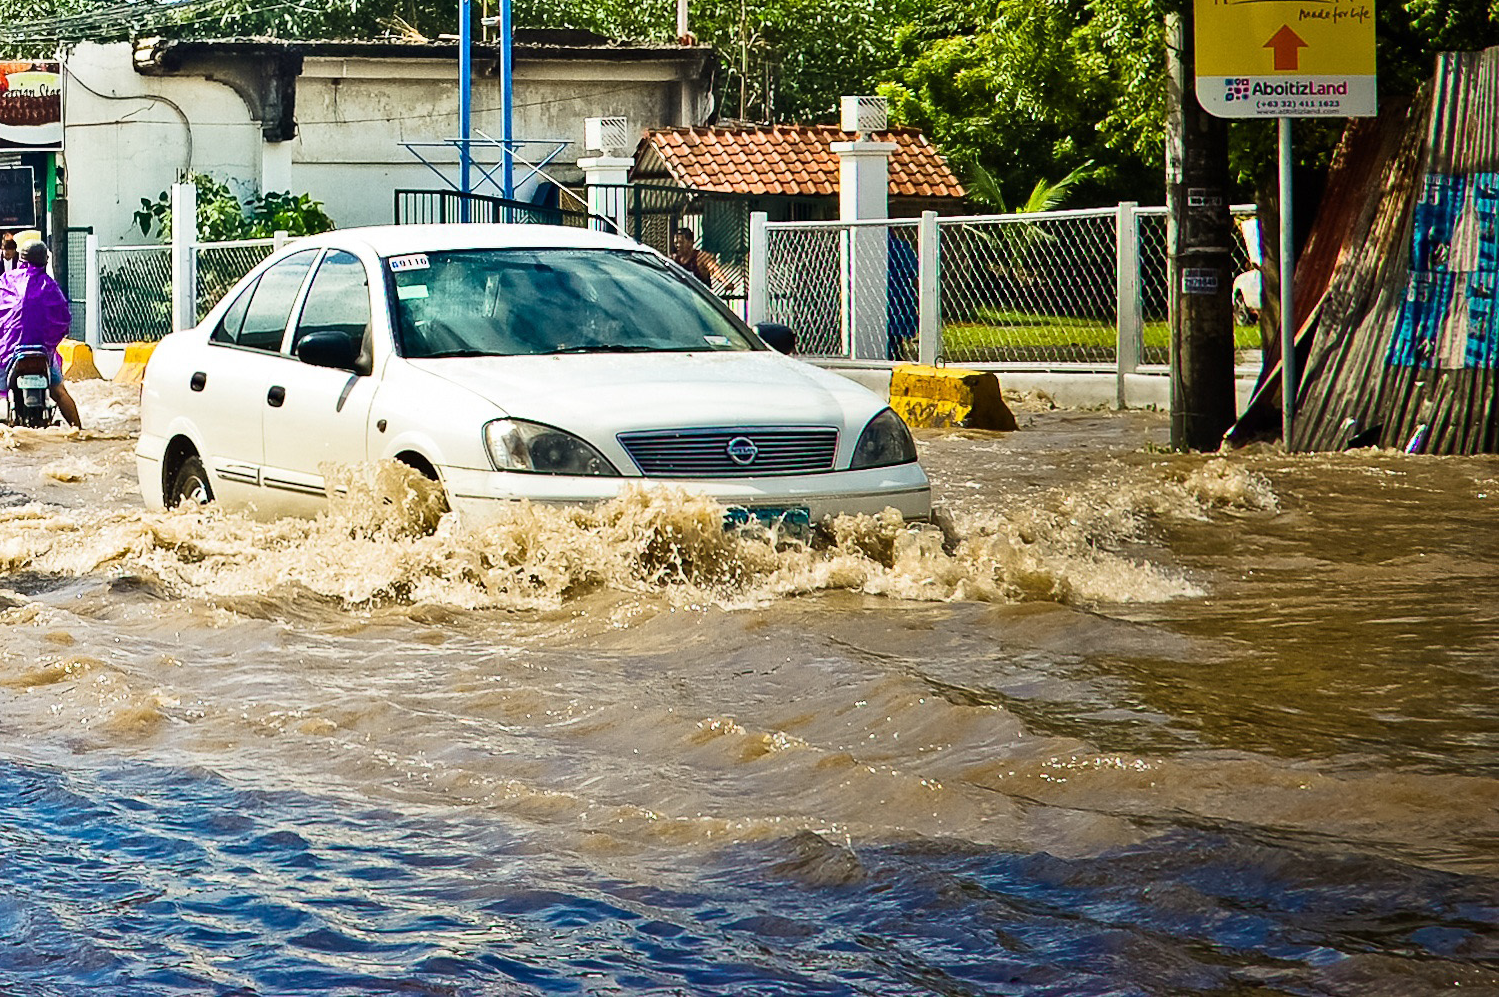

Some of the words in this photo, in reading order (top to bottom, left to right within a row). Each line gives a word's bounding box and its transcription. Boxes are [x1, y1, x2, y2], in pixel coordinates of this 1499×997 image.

[1299, 7, 1330, 21] made
[1333, 6, 1349, 24] for
[1252, 80, 1348, 96] AboitizLand
[1299, 100, 1315, 108] 411
